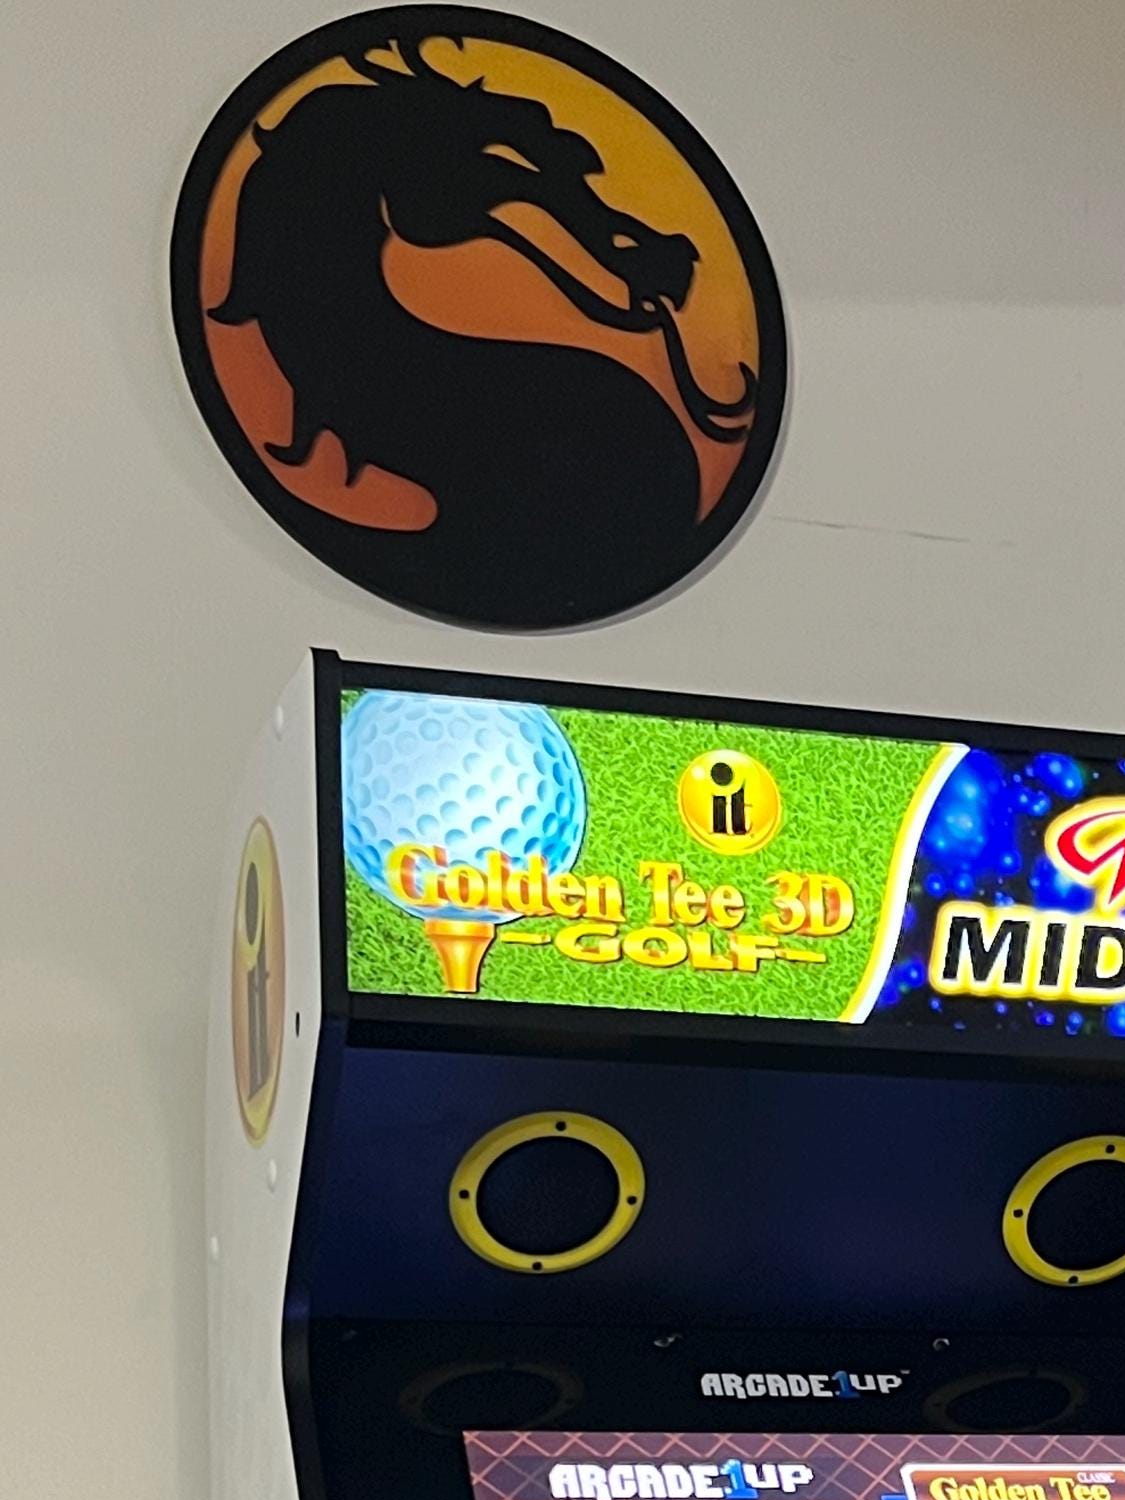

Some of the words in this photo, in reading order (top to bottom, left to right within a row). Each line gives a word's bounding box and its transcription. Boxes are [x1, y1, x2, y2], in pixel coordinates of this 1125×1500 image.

[386, 843, 627, 924] Golden
[639, 860, 746, 929] Tee
[765, 869, 855, 936] 3D
[554, 923, 779, 972] GOLF
